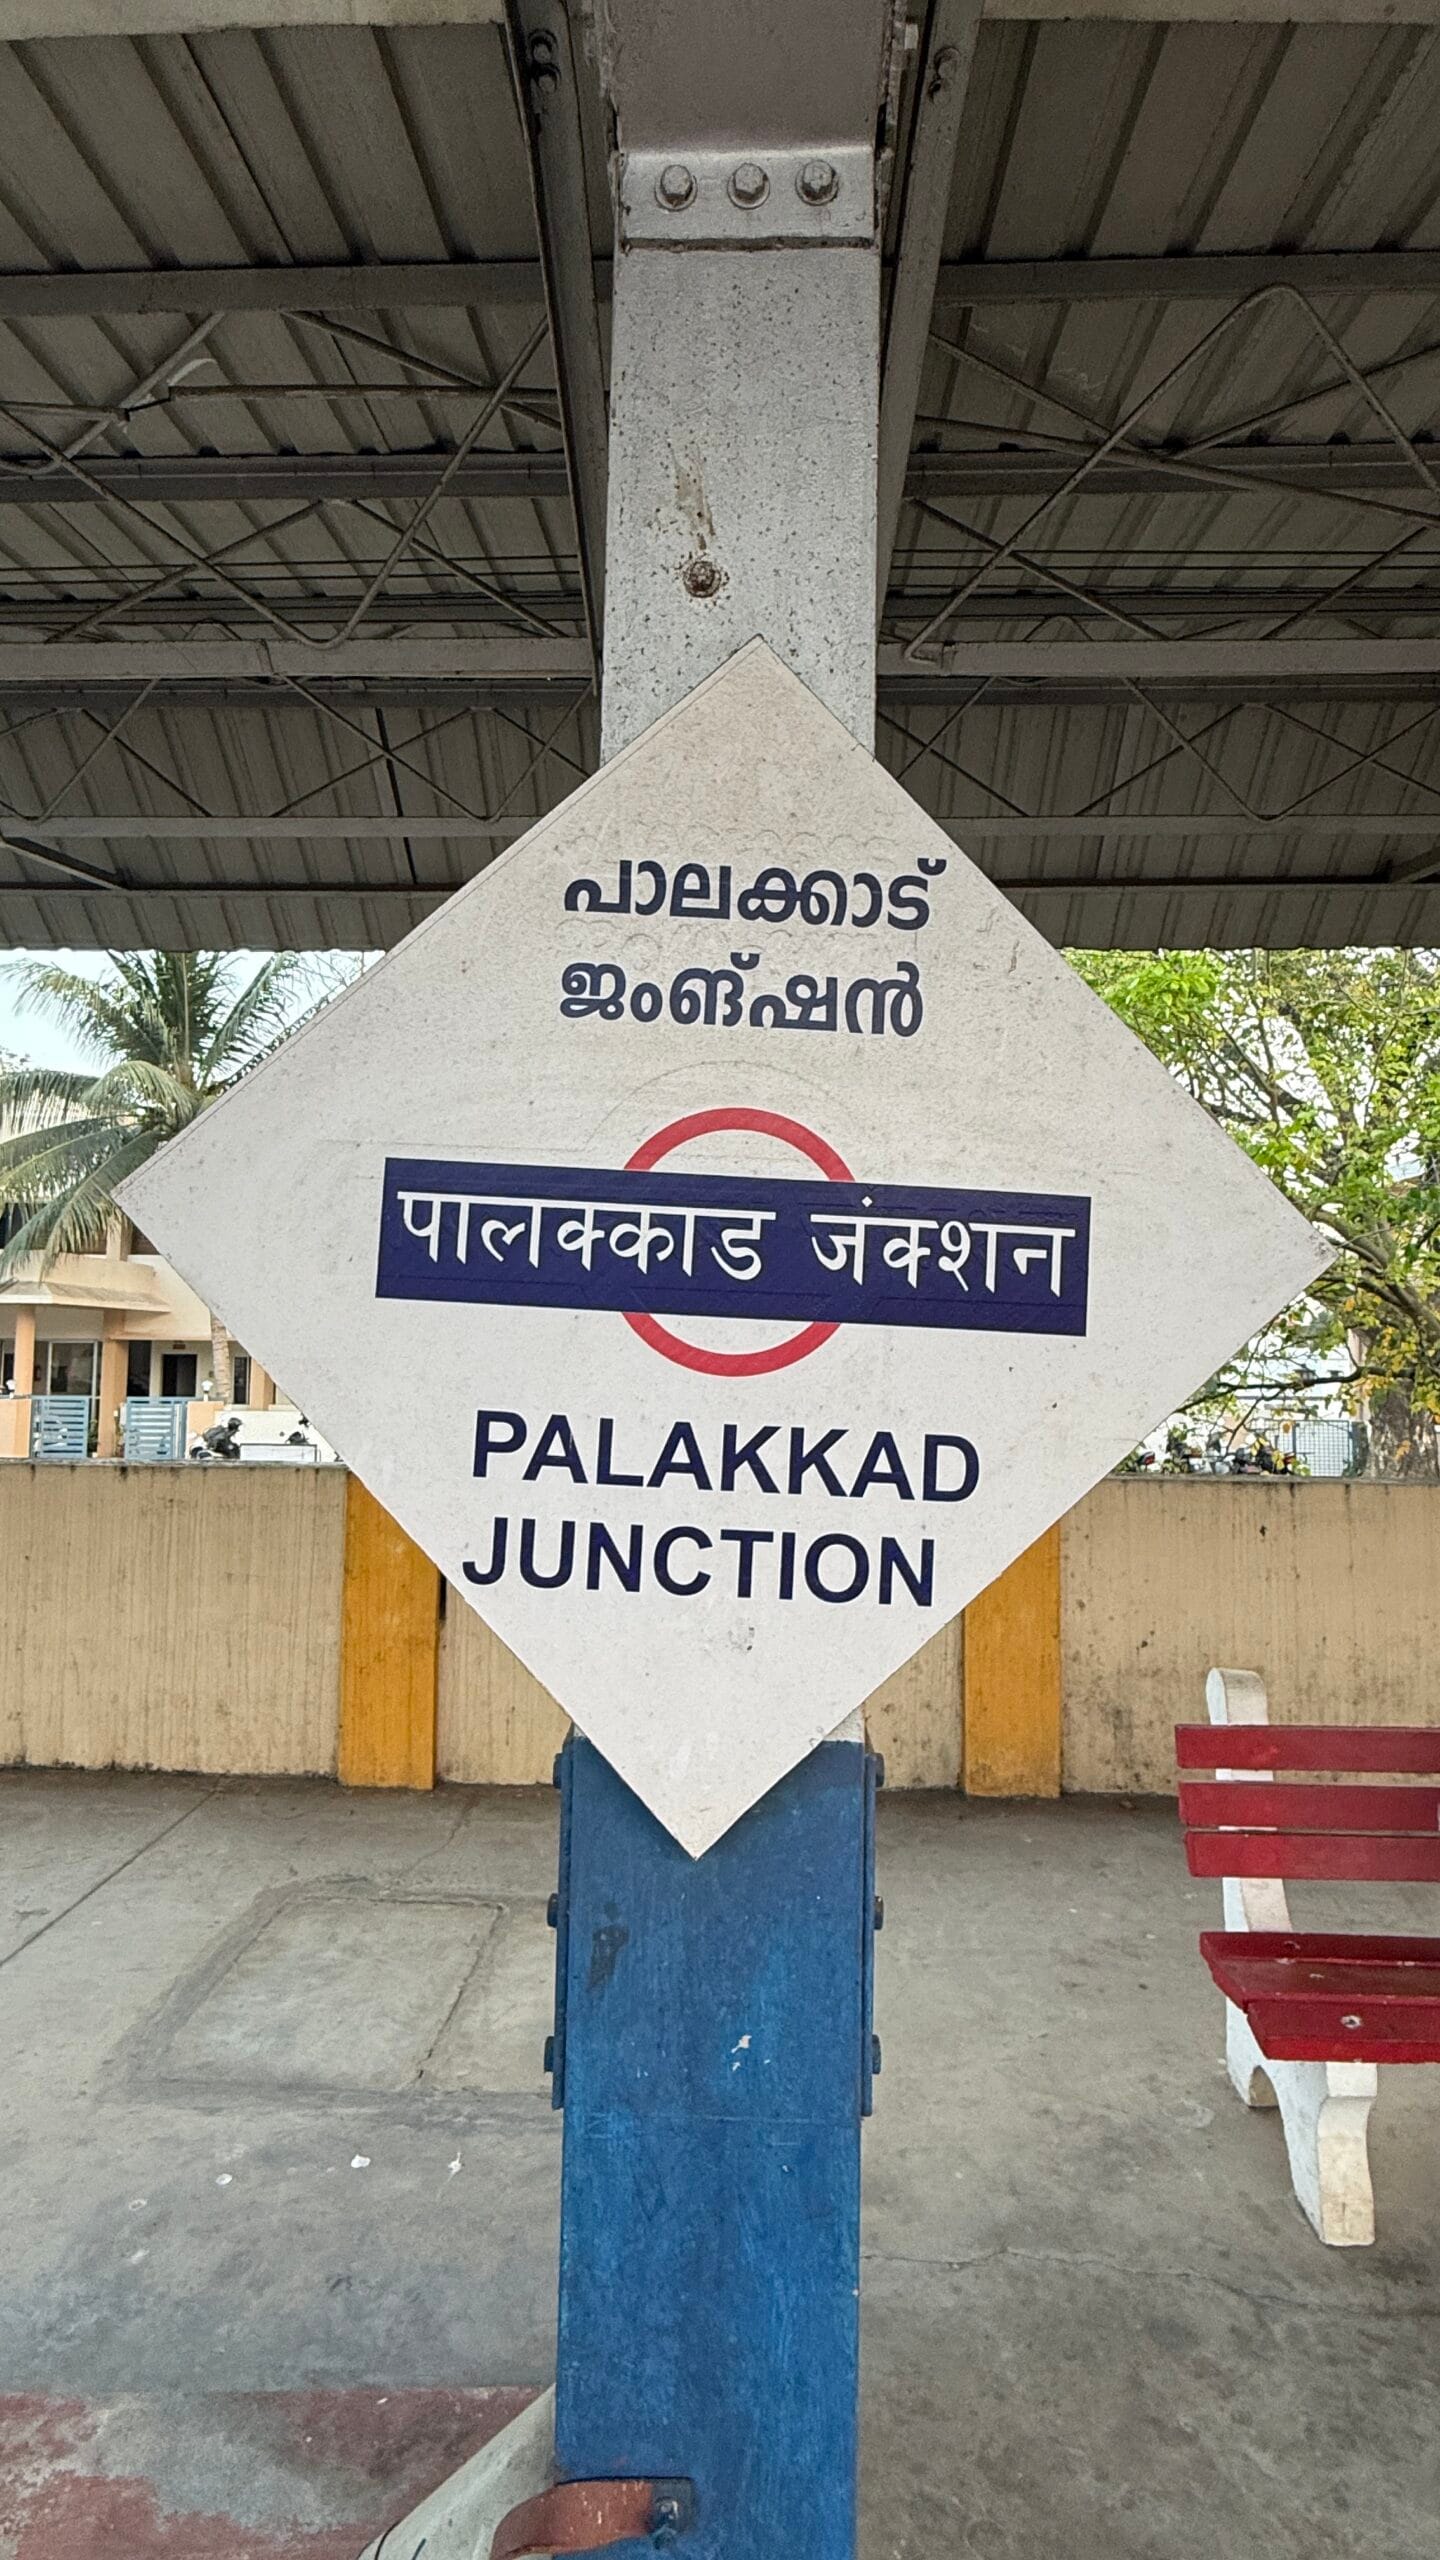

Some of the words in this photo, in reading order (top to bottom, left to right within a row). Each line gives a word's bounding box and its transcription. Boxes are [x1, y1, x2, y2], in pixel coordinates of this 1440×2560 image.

[564, 857, 947, 931] പാലക്കാട്
[396, 1191, 777, 1281] पालक्काड
[810, 1195, 1077, 1297] जंक्शन
[472, 1409, 980, 1502] PALAKKAD
[462, 1517, 935, 1607] JUNCTION
